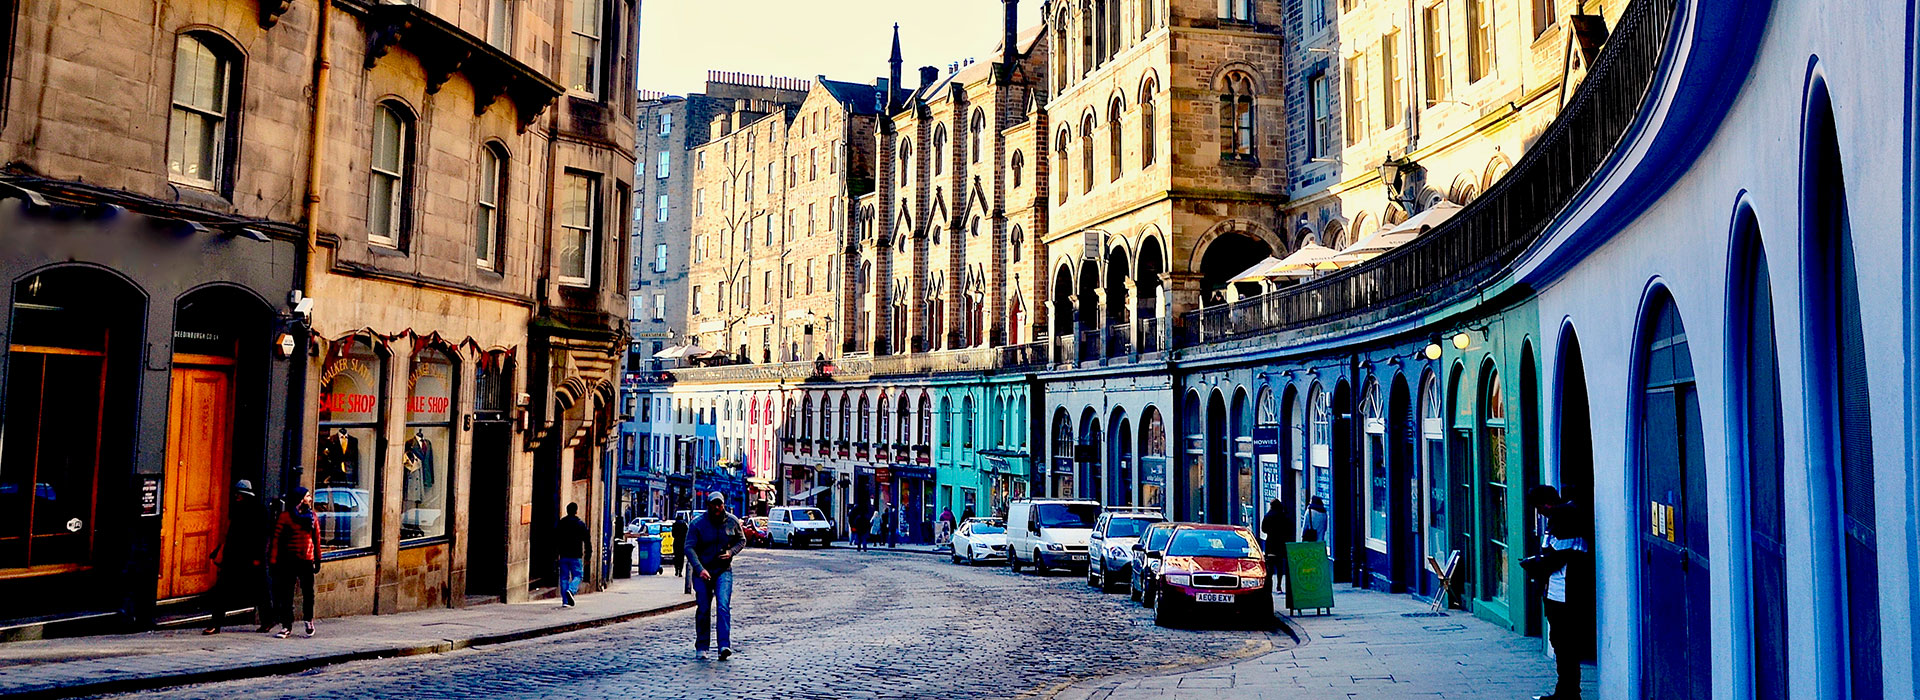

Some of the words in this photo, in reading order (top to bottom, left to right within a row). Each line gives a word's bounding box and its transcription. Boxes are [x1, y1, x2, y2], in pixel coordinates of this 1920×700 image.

[320, 358, 348, 388] WALKER
[319, 393, 345, 412] SALE
[348, 393, 376, 413] SHOP
[406, 396, 425, 413] ALE
[428, 396, 449, 414] SHOP
